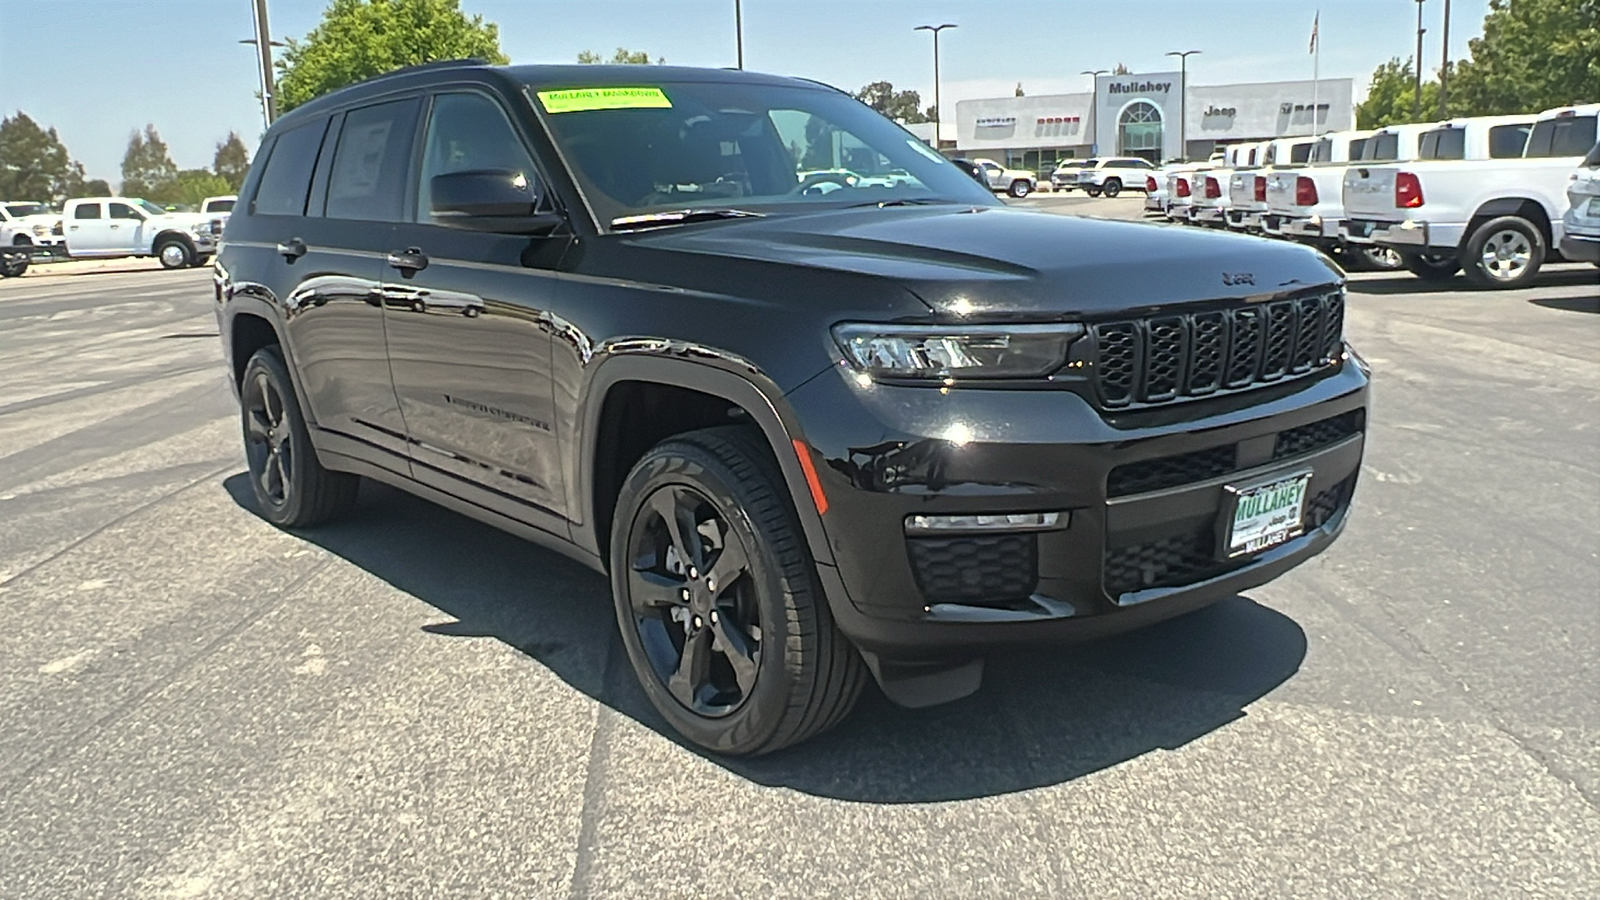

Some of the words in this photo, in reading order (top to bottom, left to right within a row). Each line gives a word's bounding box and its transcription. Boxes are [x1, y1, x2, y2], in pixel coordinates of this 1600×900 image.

[1108, 80, 1172, 95] Mullahey
[1203, 105, 1237, 118] Jeep
[1236, 483, 1304, 521] MULLAHEY
